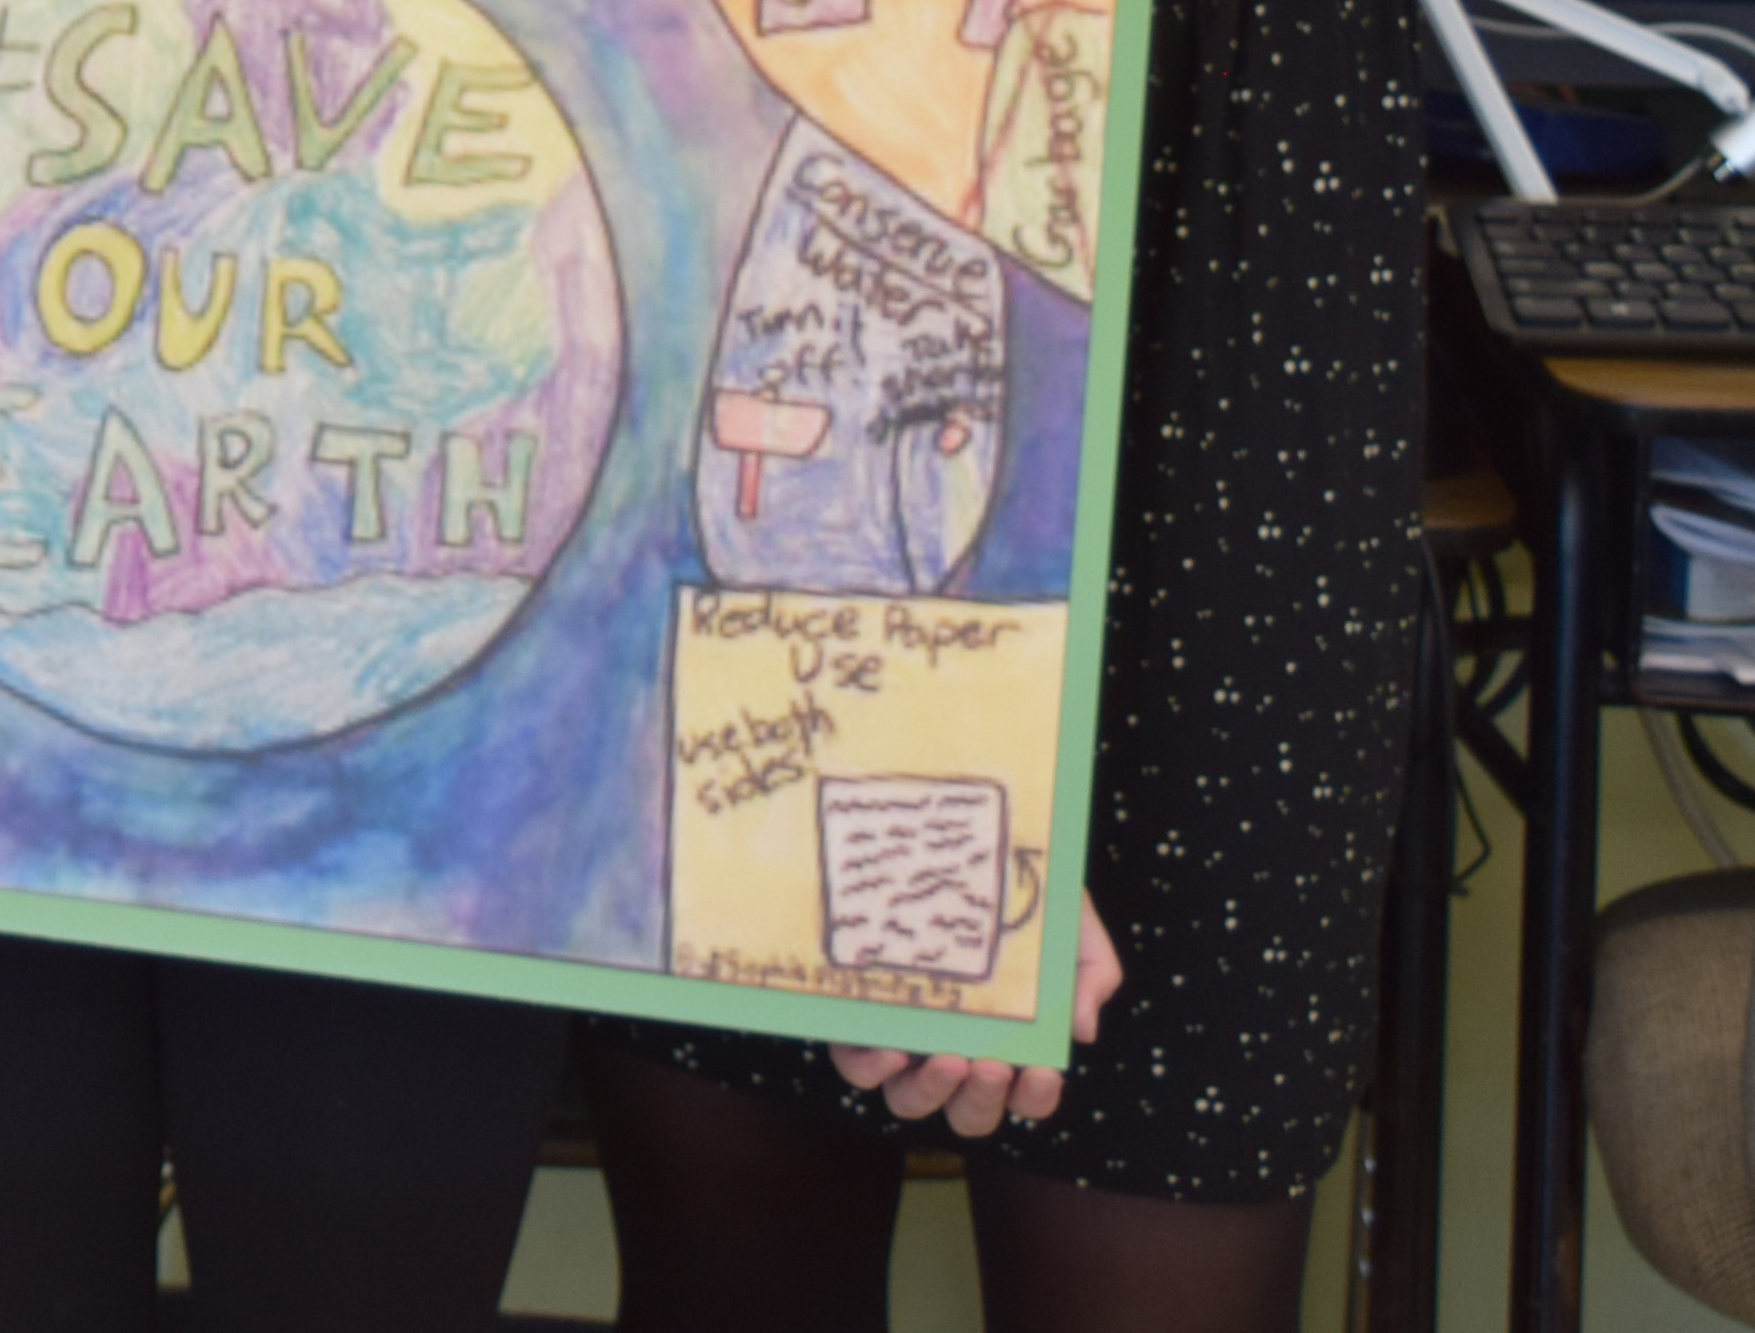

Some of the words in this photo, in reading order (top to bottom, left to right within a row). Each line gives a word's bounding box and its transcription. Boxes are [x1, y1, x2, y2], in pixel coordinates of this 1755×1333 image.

[1011, 21, 1103, 270] Garbage
[36, 217, 356, 378] OUR
[791, 149, 990, 303] Conserve
[692, 589, 861, 641] Reduce
[883, 605, 1021, 671] Paper
